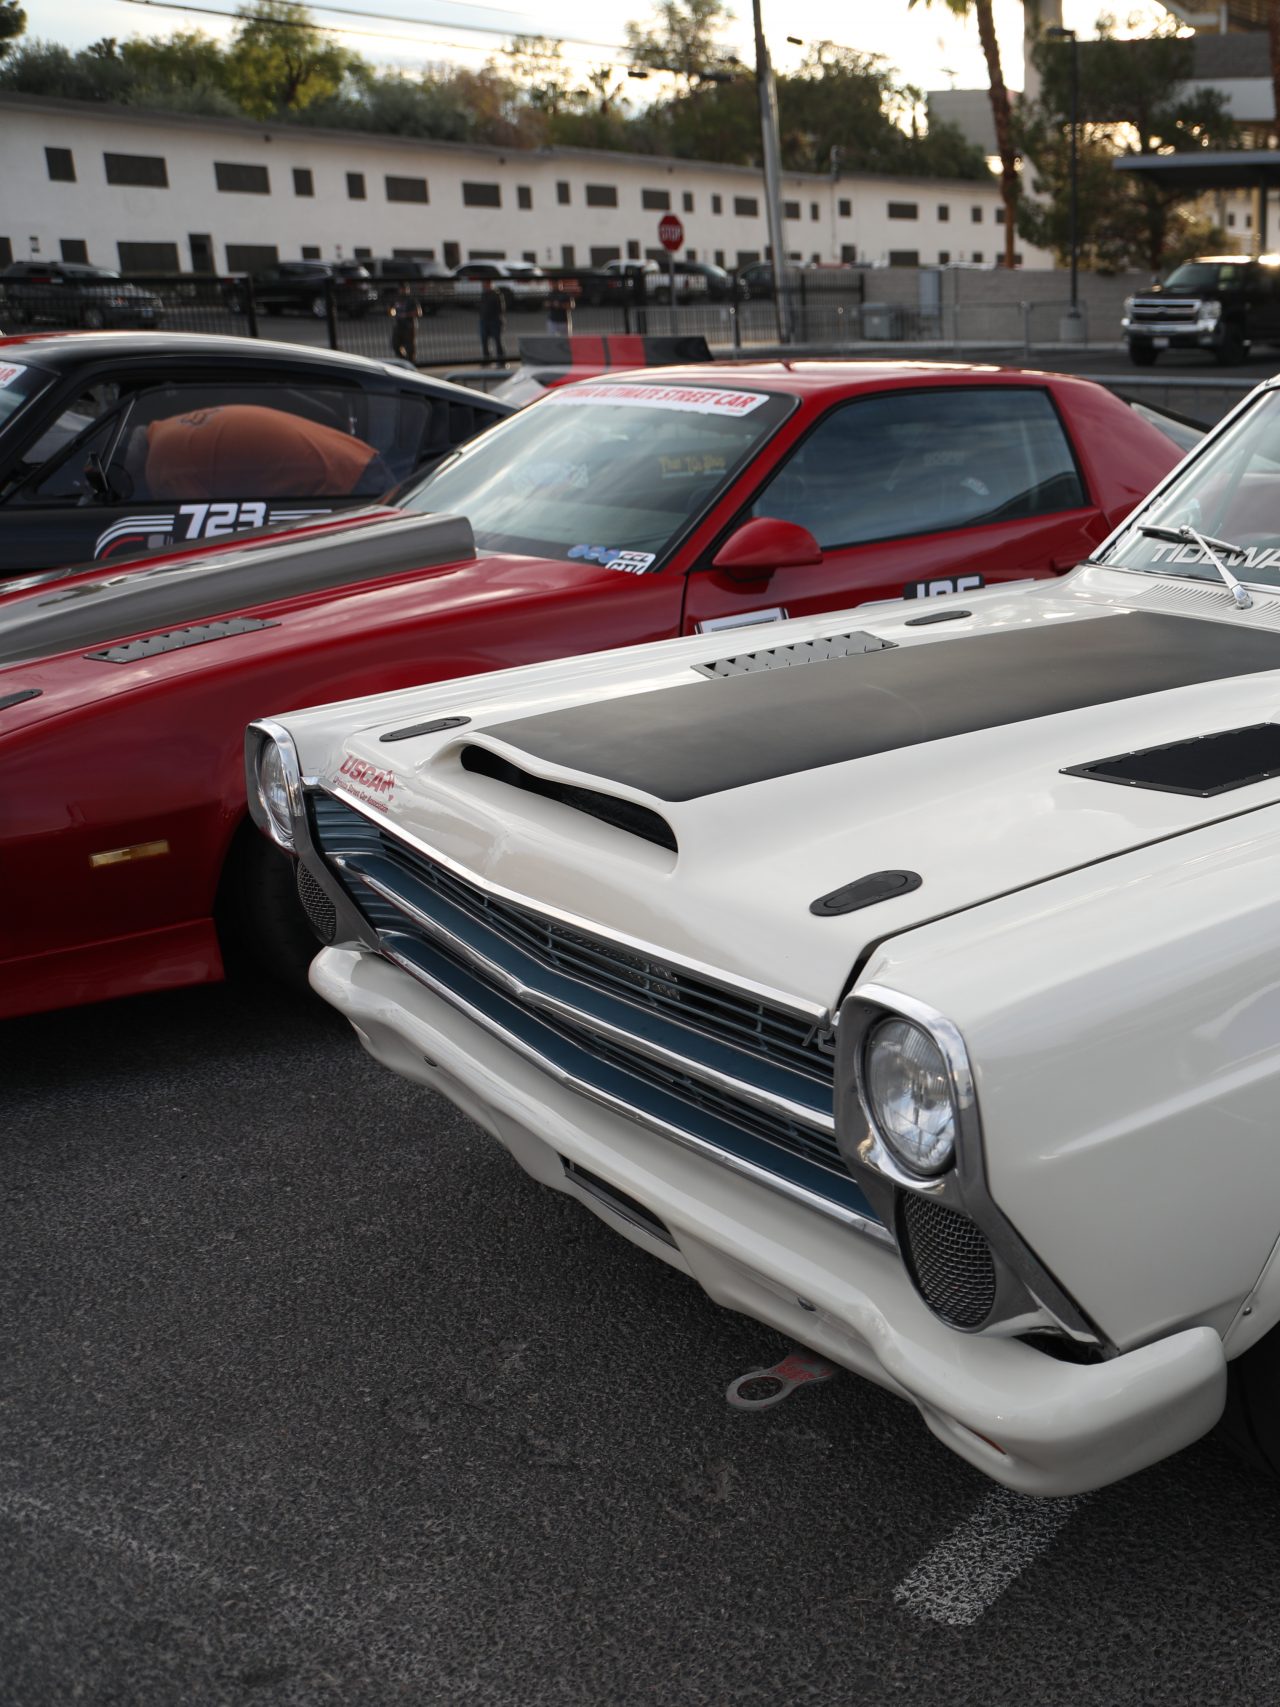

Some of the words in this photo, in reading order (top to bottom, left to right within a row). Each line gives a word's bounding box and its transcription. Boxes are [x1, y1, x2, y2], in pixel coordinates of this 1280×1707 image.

[660, 225, 681, 240] STOP
[660, 391, 715, 407] STREET
[713, 394, 757, 409] CAR
[179, 502, 267, 540] 723
